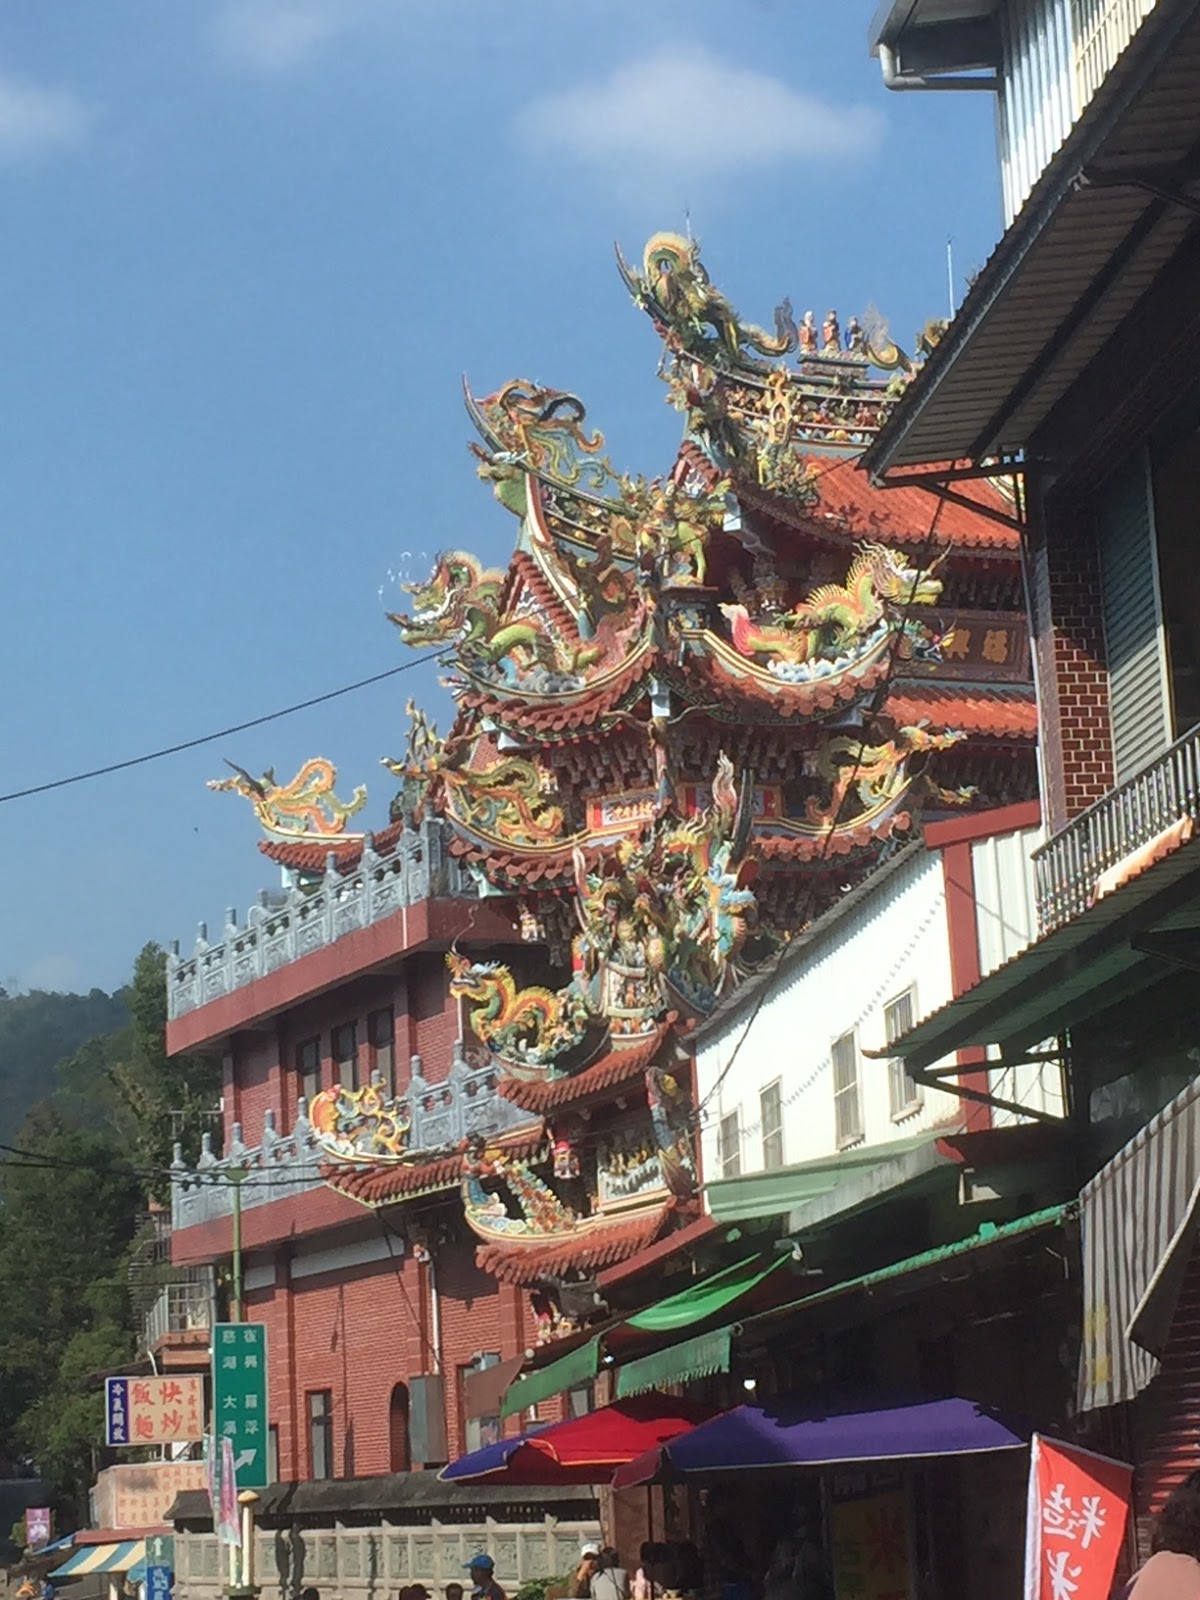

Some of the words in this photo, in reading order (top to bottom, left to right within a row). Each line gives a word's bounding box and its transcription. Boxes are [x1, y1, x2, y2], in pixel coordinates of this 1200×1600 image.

[222, 1329, 237, 1370] 慈湖
[243, 1328, 258, 1369] 復興
[112, 1383, 125, 1440] 冷氣開放
[131, 1382, 155, 1439] 飯麵
[159, 1381, 183, 1437] 快炒
[222, 1395, 237, 1435] 大溪
[244, 1394, 259, 1435] 羅浮
